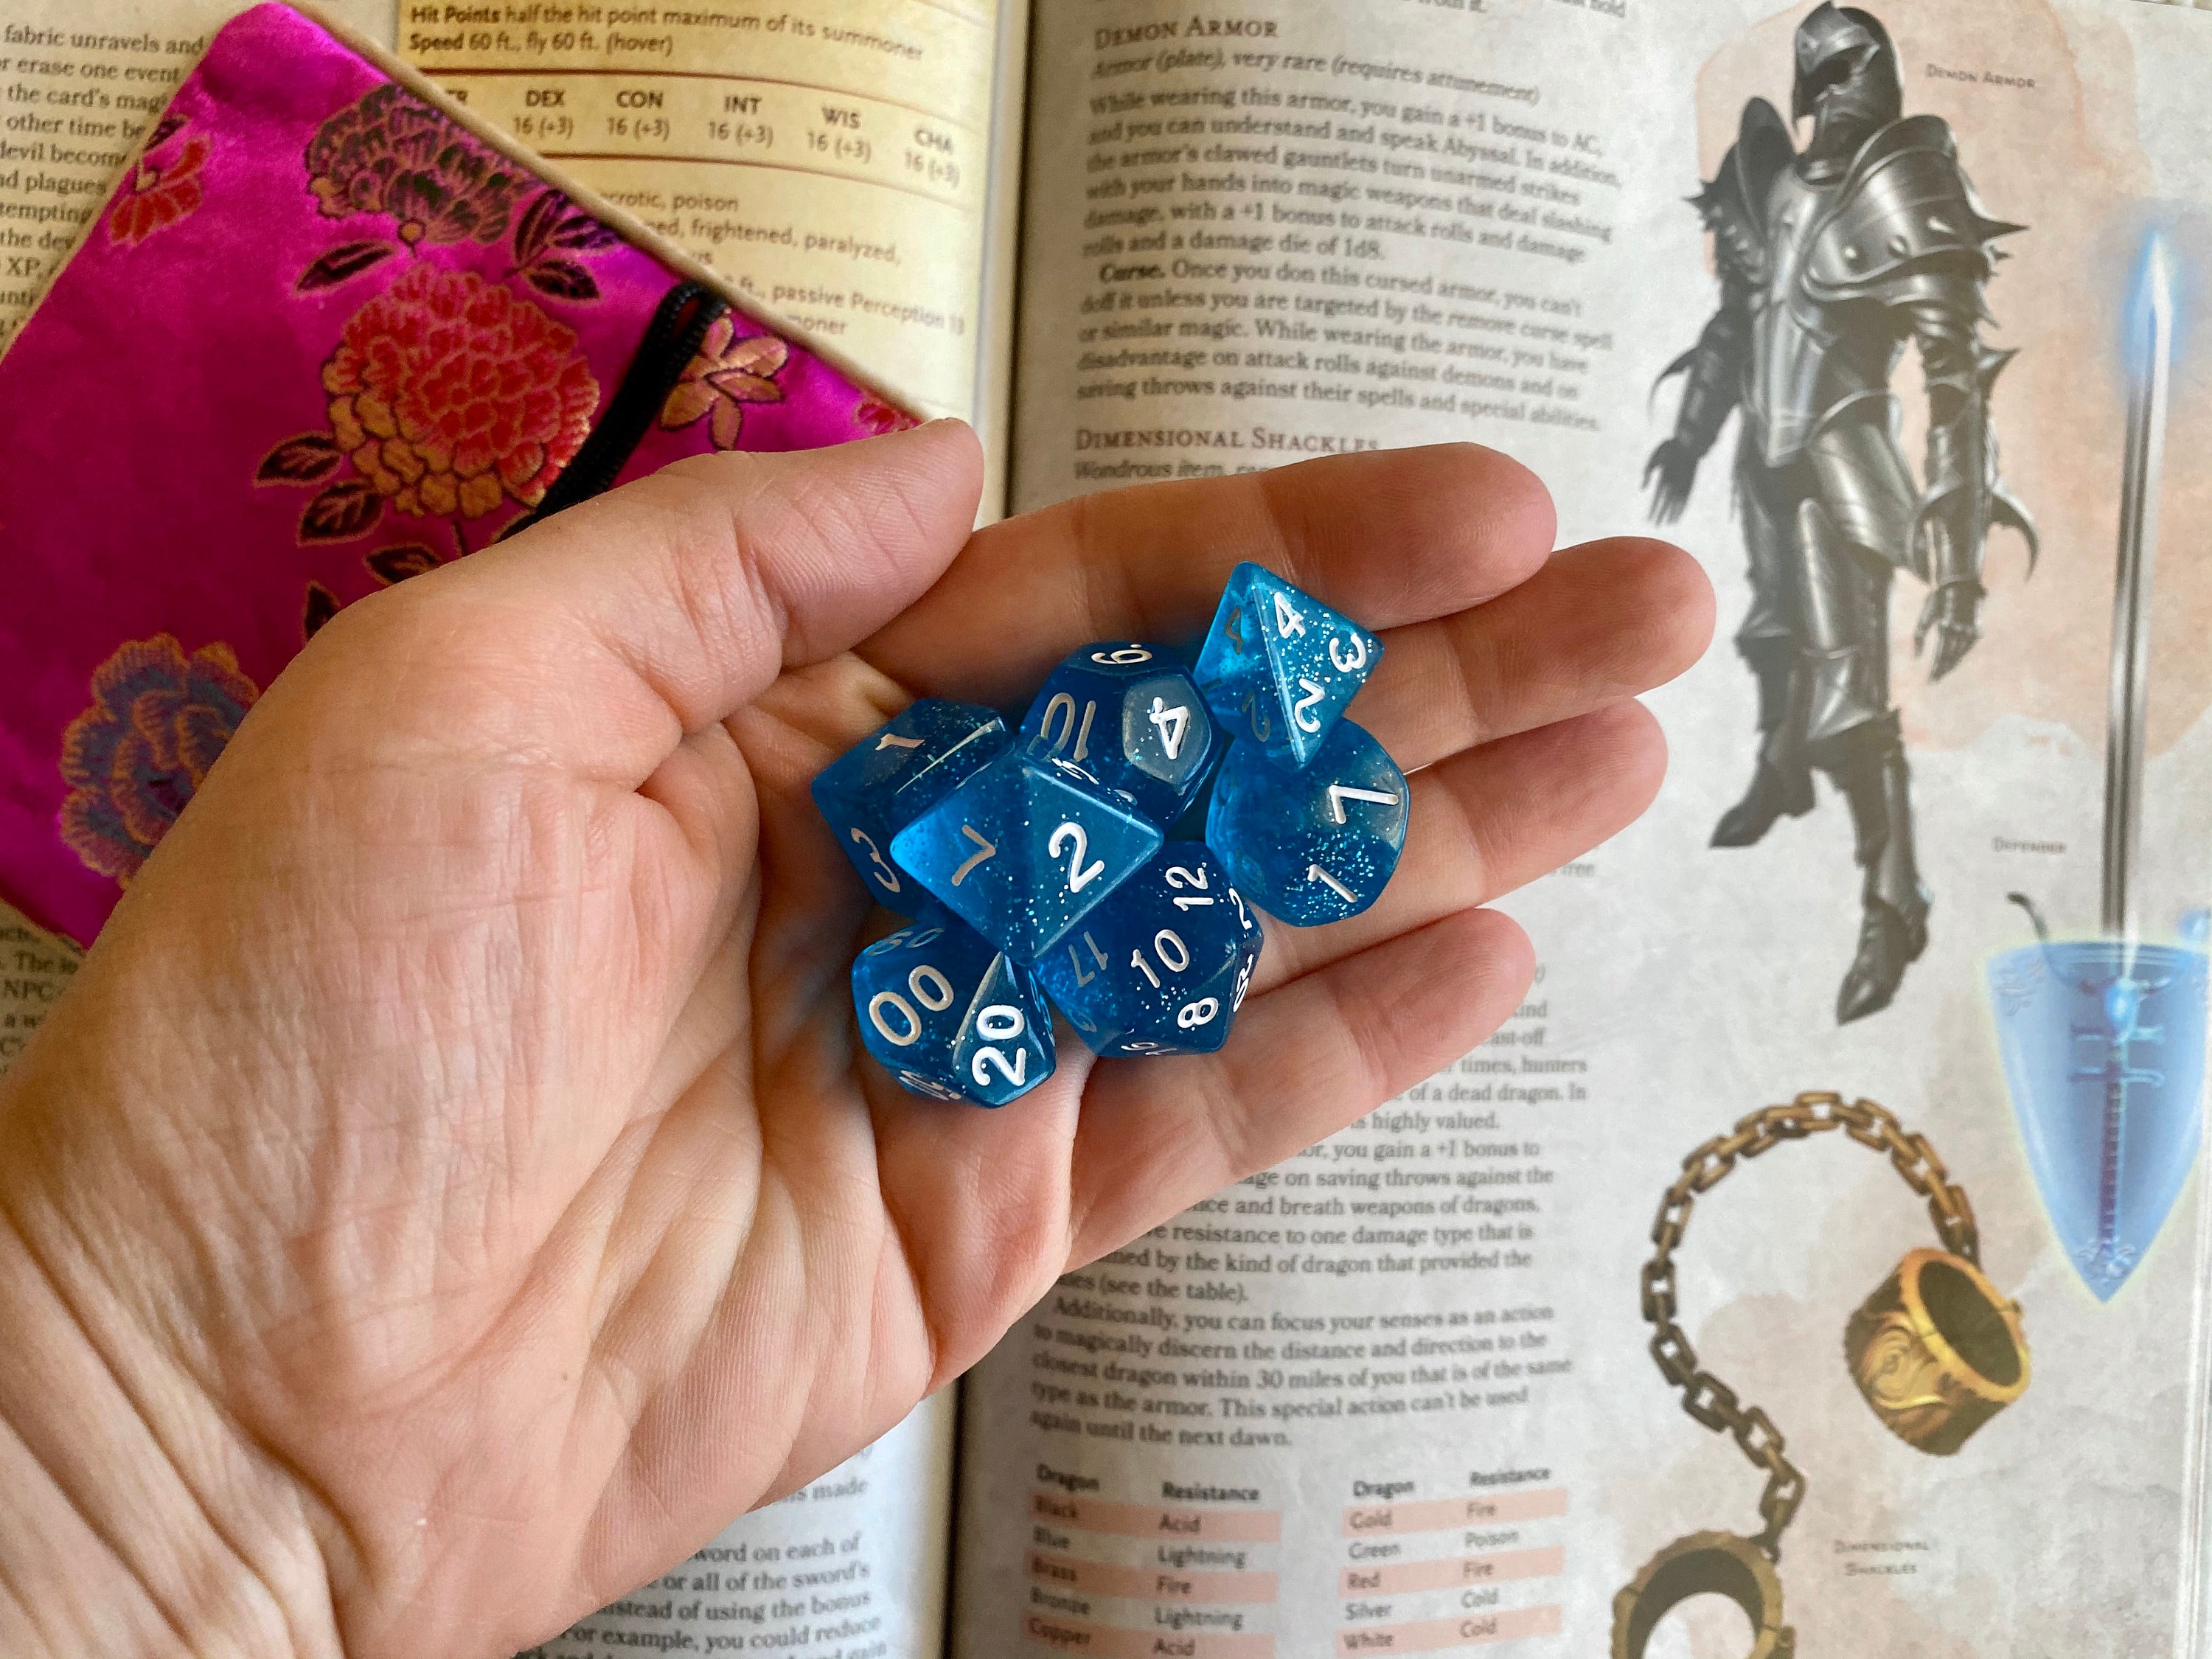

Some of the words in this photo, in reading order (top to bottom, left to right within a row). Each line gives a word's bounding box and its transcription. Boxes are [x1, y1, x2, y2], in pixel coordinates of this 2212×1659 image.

[4, 24, 64, 46] fabric
[72, 32, 160, 52] unravels
[166, 35, 205, 55] and
[408, 32, 465, 55] Speed
[469, 32, 492, 50] 60
[526, 29, 547, 55] fly
[552, 32, 574, 50] 60
[580, 30, 601, 51] ft.
[606, 32, 672, 58] (hover)
[411, 5, 439, 23] Hit
[444, 5, 501, 23] Points
[505, 3, 540, 23] half
[543, 7, 572, 22] the
[577, 4, 602, 23] hit
[608, 6, 656, 27] point
[664, 9, 760, 28] maximum
[766, 13, 789, 32] of
[793, 19, 815, 37] its
[822, 27, 922, 60] summoner
[1183, 15, 1279, 38] ARMOR
[17, 58, 74, 77] erase
[80, 63, 118, 80] one
[125, 66, 179, 83] event
[7, 83, 41, 102] the
[46, 88, 110, 108] card's
[7, 113, 63, 133] other
[70, 117, 116, 137] time
[525, 88, 566, 108] DEX
[616, 89, 664, 108] CON
[723, 95, 762, 114] INT
[821, 107, 862, 129] WIS
[915, 128, 954, 154] CHA
[513, 114, 532, 134] 16
[538, 114, 574, 139] (+3)
[606, 115, 628, 136] 16
[632, 115, 670, 142] (+3)
[709, 120, 730, 141] 16
[736, 122, 773, 148] (+3)
[807, 129, 829, 152] 16
[834, 133, 872, 165] (+3)
[905, 149, 923, 172] 16
[26, 173, 107, 195] plagues
[672, 195, 738, 212] poison
[691, 218, 799, 247] frightened,
[804, 225, 901, 267] paralyzed,
[1099, 263, 1165, 284] Curse.
[1172, 258, 1226, 279] Once
[1232, 264, 1270, 283] you
[1276, 263, 1315, 283] don
[1321, 267, 1360, 286] this
[1365, 274, 1433, 295] cursed
[1505, 293, 1536, 310] you
[773, 283, 844, 307] passive
[849, 290, 945, 330] Perception
[1075, 428, 1245, 451] DIMENSIONAL
[1273, 591, 1306, 639] 4
[1330, 633, 1366, 672] 3
[1294, 678, 1324, 733] 2
[1150, 697, 1189, 760] 4
[850, 827, 901, 894] 3
[1048, 821, 1105, 894] 2
[1166, 866, 1214, 911] 12
[1308, 863, 1358, 903] 1
[1131, 928, 1189, 988] 10
[869, 964, 954, 1046] 00
[1177, 997, 1219, 1029] 8
[972, 1004, 1026, 1086] 20
[1409, 1082, 1428, 1101] of
[1432, 1087, 1442, 1101] a
[1448, 1082, 1492, 1101] dead
[1498, 1082, 1564, 1106] dragon.
[1569, 1082, 1587, 1100] In
[1372, 1111, 1432, 1133] highly
[1436, 1111, 1500, 1130] valued.
[1234, 1195, 1273, 1215] and
[1280, 1197, 1344, 1215] breath
[1350, 1201, 1435, 1219] weapons
[1440, 1194, 1461, 1214] of
[1173, 1222, 1281, 1242] resistance
[1285, 1228, 1307, 1245] to
[1310, 1229, 1347, 1245] one
[1352, 1225, 1429, 1248] damage
[1433, 1228, 1472, 1248] type
[1478, 1220, 1512, 1242] that
[1517, 1223, 1534, 1240] is
[1157, 1249, 1181, 1273] by
[1186, 1251, 1220, 1271] the
[1225, 1252, 1271, 1273] kind
[1276, 1253, 1299, 1274] of
[1301, 1254, 1372, 1276] dragon
[1377, 1252, 1413, 1272] that
[1420, 1248, 1500, 1276] provided
[1503, 1248, 1533, 1268] the
[1099, 1273, 1142, 1295] (see
[1146, 1279, 1180, 1298] the
[1186, 1281, 1248, 1304] table).
[1036, 1463, 1099, 1493] Dragon
[1161, 1480, 1260, 1502] Resistance
[1352, 1479, 1416, 1500] Dragon
[1158, 1513, 1201, 1534] Acid
[1349, 1510, 1393, 1531] Gold
[1466, 1500, 1498, 1520] Fire
[1157, 1545, 1248, 1570] Lightning
[1348, 1540, 1402, 1560] Green
[1464, 1530, 1520, 1550] Poison
[664, 1574, 685, 1590] or
[692, 1572, 720, 1591] all
[725, 1572, 748, 1591] of
[753, 1571, 787, 1590] the
[793, 1560, 871, 1588] sword's
[1156, 1574, 1192, 1596] Fire
[1347, 1571, 1382, 1590] Red
[1462, 1559, 1495, 1579] Fire
[677, 1599, 701, 1620] of
[706, 1602, 765, 1624] using
[771, 1597, 806, 1618] the
[811, 1591, 872, 1615] bonus
[1155, 1605, 1244, 1632] Lightning
[1345, 1601, 1392, 1621] Silver
[1461, 1587, 1500, 1610] Cold
[602, 1628, 700, 1653] example,
[705, 1635, 745, 1654] you
[749, 1625, 810, 1649] could
[1152, 1638, 1196, 1658] Acid
[1343, 1632, 1395, 1652] White
[1459, 1618, 1498, 1639] Cold
